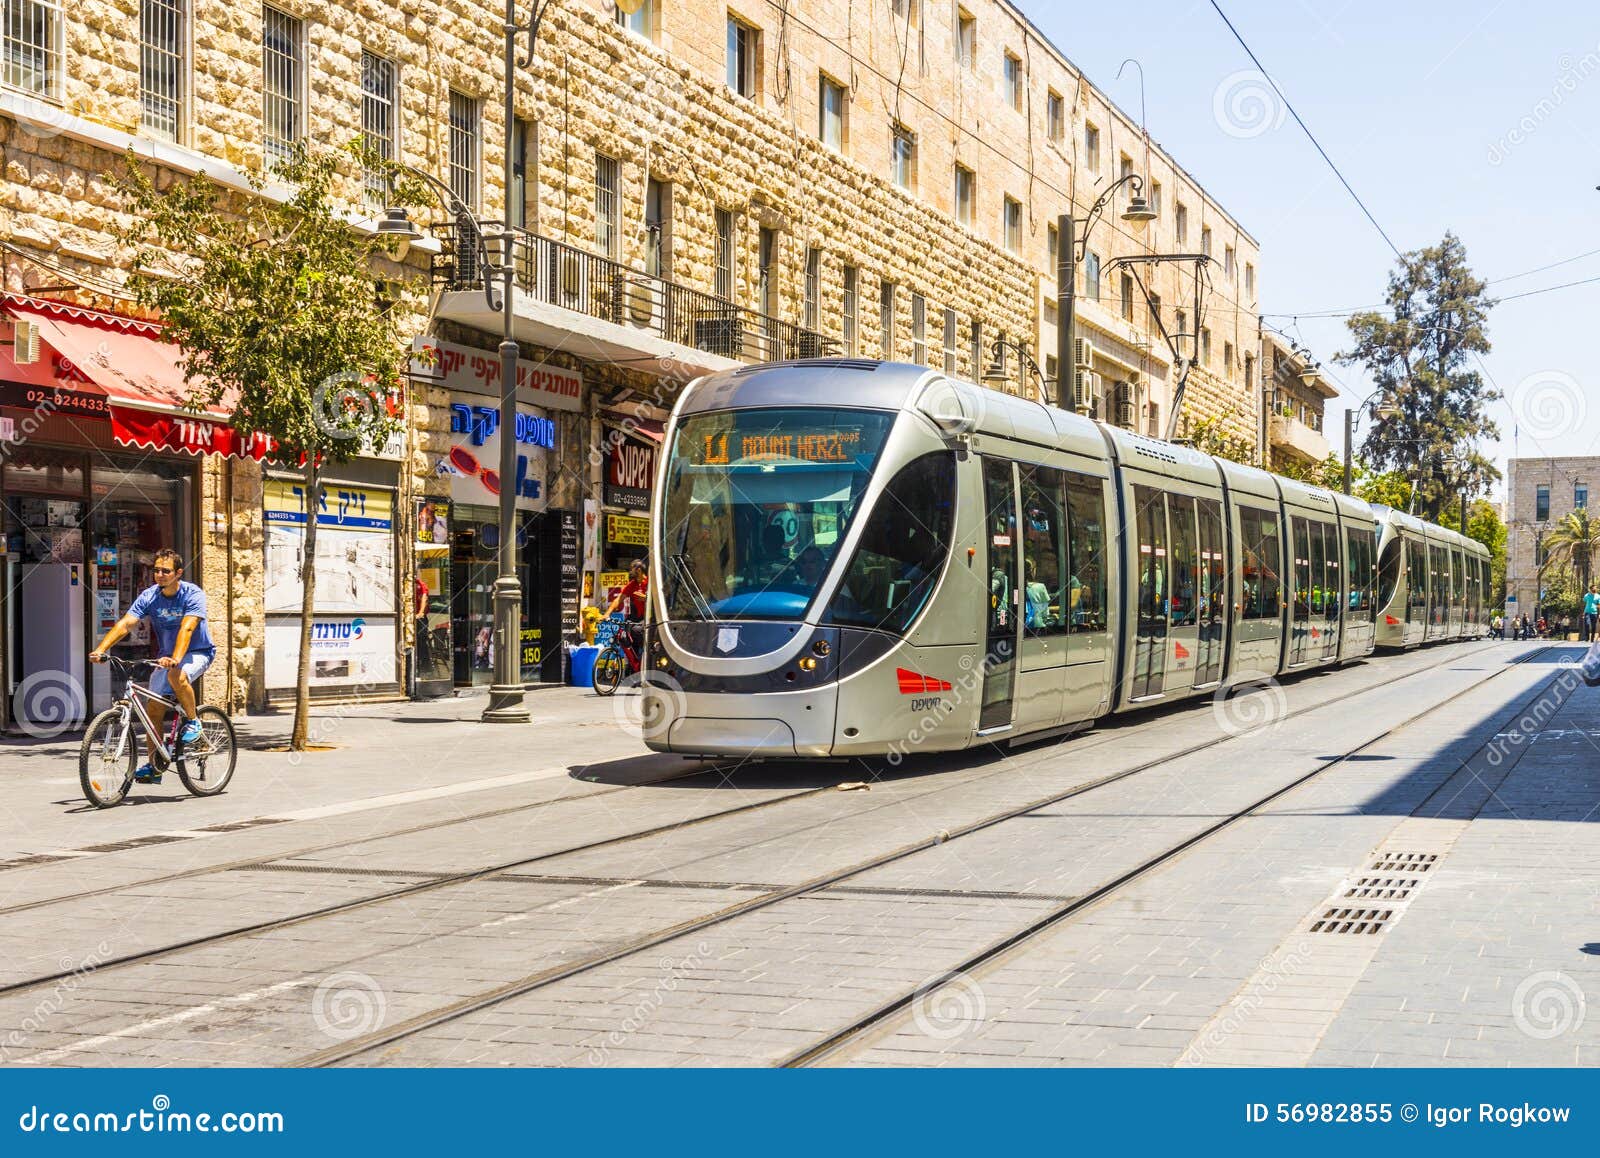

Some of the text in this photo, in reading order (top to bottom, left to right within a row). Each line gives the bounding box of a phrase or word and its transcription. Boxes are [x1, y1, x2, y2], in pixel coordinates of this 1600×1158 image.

[471, 356, 527, 386] וקפי
[530, 368, 579, 398] מותגים
[26, 390, 112, 412] 02-6244333
[450, 403, 555, 449] אופטקה
[742, 435, 793, 461] MOUNT
[617, 442, 651, 490] Super
[293, 485, 328, 514] אר
[524, 647, 541, 664] 150
